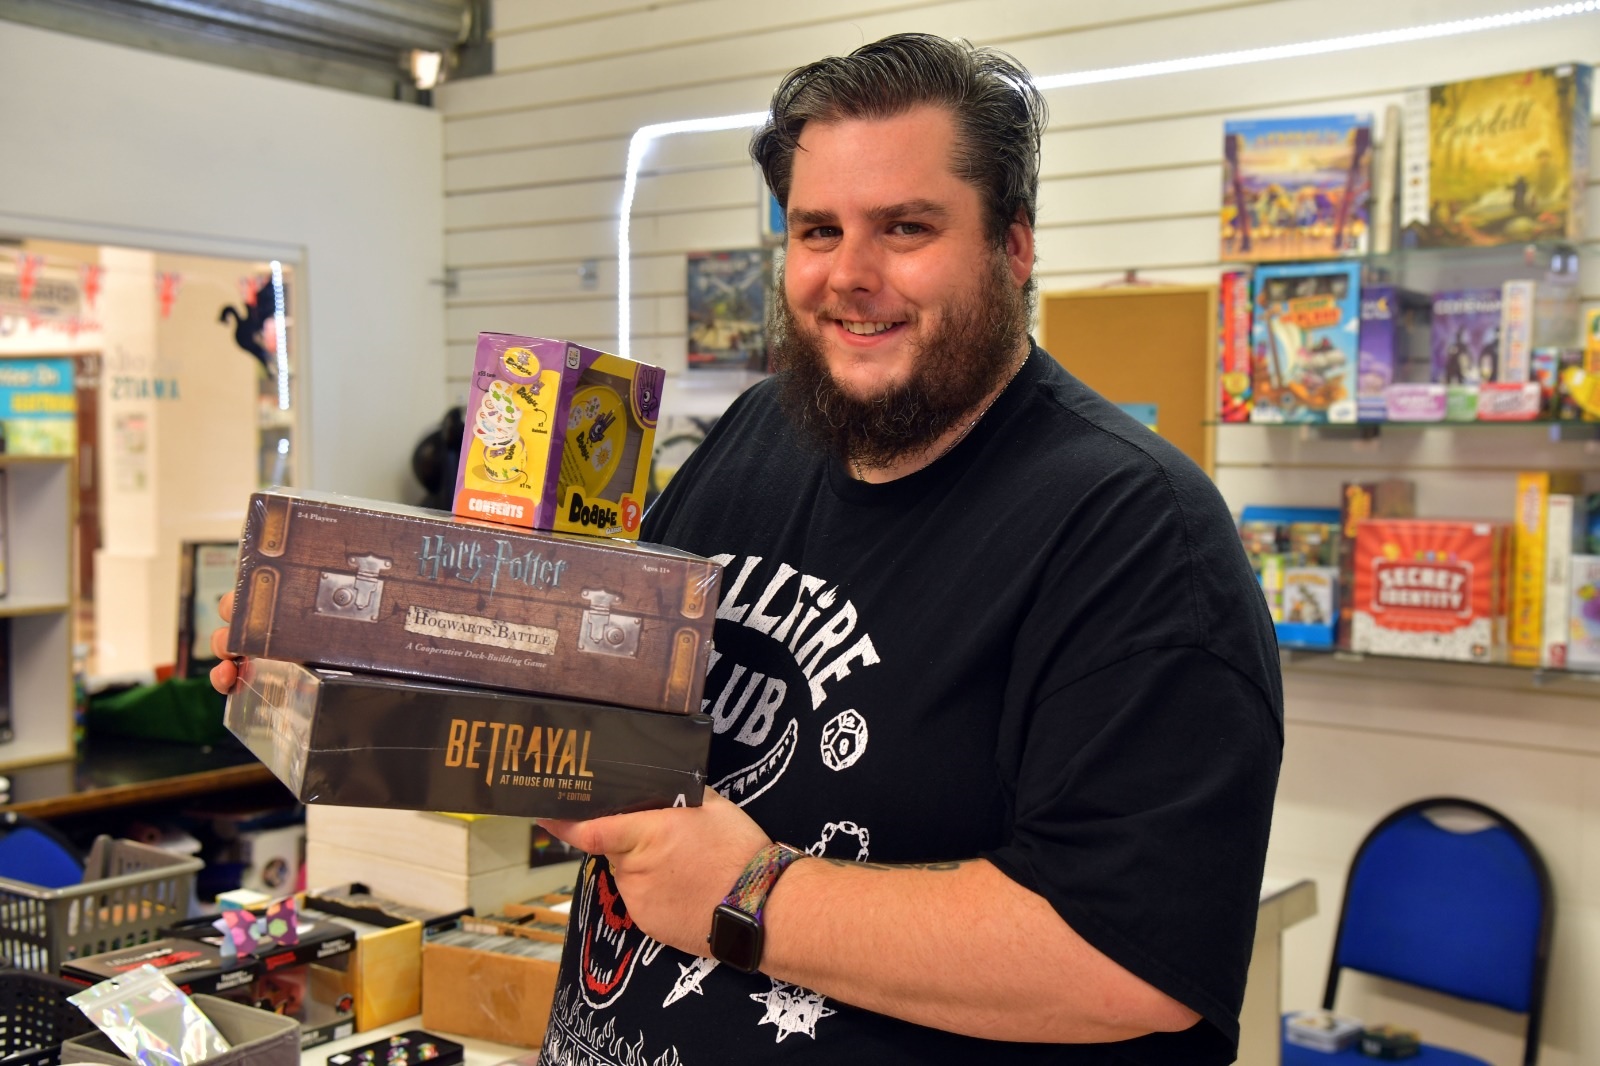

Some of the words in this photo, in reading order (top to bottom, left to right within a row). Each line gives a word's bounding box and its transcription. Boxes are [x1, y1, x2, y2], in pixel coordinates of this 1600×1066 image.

[310, 512, 338, 523] Players
[468, 496, 524, 519] CONTENTS
[417, 534, 483, 584] Harry
[489, 538, 569, 601] Potter
[641, 564, 659, 574] Ages
[1378, 566, 1465, 591] SECRET
[1379, 588, 1463, 610] IDENTITY
[405, 642, 413, 651] A
[414, 643, 463, 657] Cooperative
[464, 650, 523, 667] Deck-Building
[523, 657, 548, 669] Game
[444, 718, 595, 787] BETRAYAL
[499, 774, 511, 785] AT
[512, 775, 542, 787] HOUSE
[542, 777, 555, 788] ON
[558, 778, 574, 790] THE
[574, 780, 593, 791] HILL
[566, 792, 591, 802] EDITION
